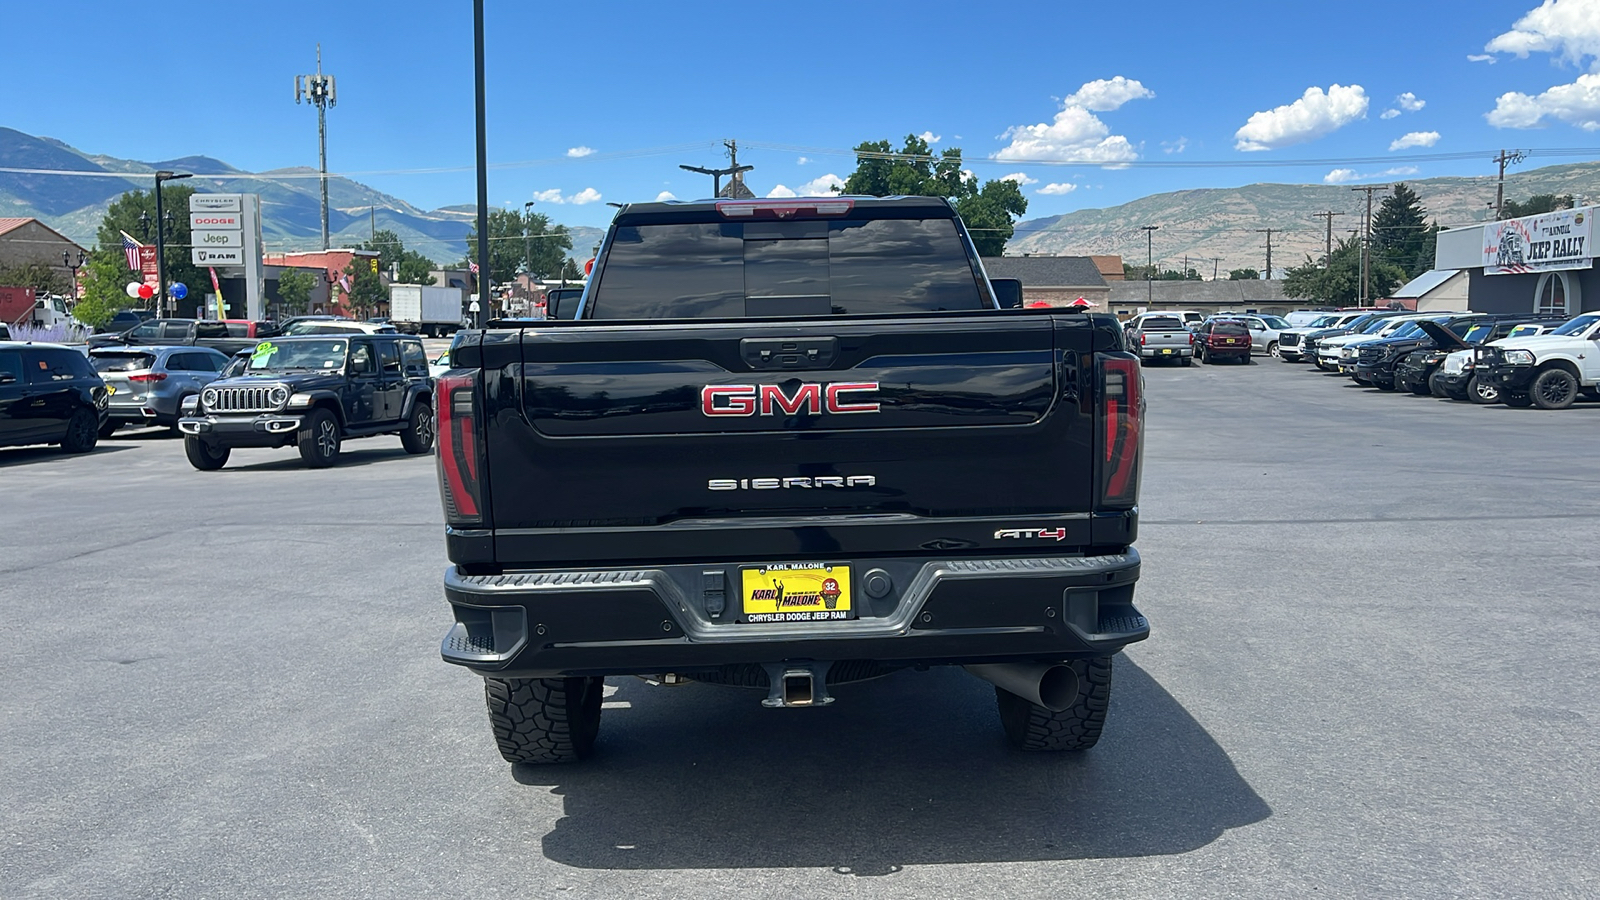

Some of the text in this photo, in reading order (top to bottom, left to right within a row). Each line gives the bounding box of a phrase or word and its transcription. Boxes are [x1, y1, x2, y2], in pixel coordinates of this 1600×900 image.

[203, 233, 229, 244] Jeep
[1527, 236, 1585, 260] JEEP RALLY
[701, 381, 881, 417] GMC
[708, 475, 876, 490] SIERRA
[994, 527, 1066, 541] AT4
[791, 562, 825, 570] MALONE
[825, 582, 836, 591] 32
[751, 589, 776, 600] KARL
[782, 595, 821, 606] MALONE
[748, 611, 847, 622] CHRYSLER DODGE JEEP RAM
